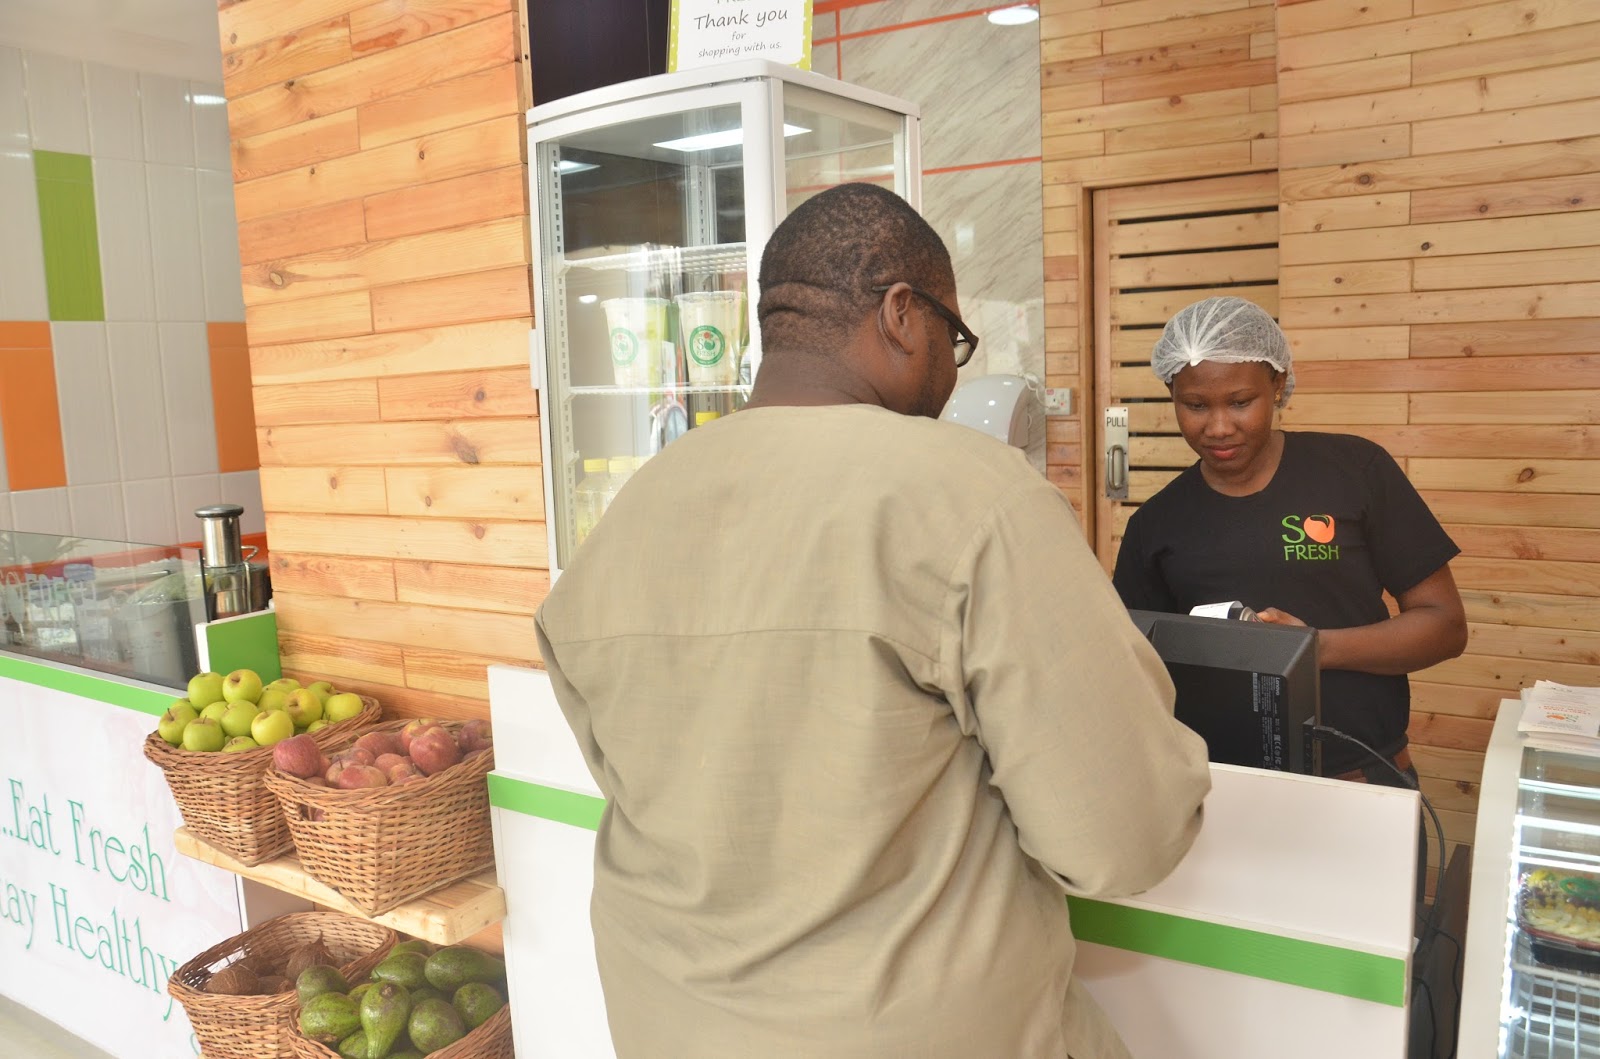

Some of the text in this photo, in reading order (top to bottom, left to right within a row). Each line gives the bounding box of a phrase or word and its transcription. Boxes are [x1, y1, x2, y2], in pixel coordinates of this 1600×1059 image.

[694, 9, 788, 29] Thank you
[731, 31, 747, 41] for
[698, 46, 741, 59] shopping
[744, 42, 766, 53] with
[1106, 416, 1127, 428] PULL
[1283, 544, 1339, 561] FRESH
[67, 799, 171, 902] Fresh
[48, 882, 179, 1021] Healthy
